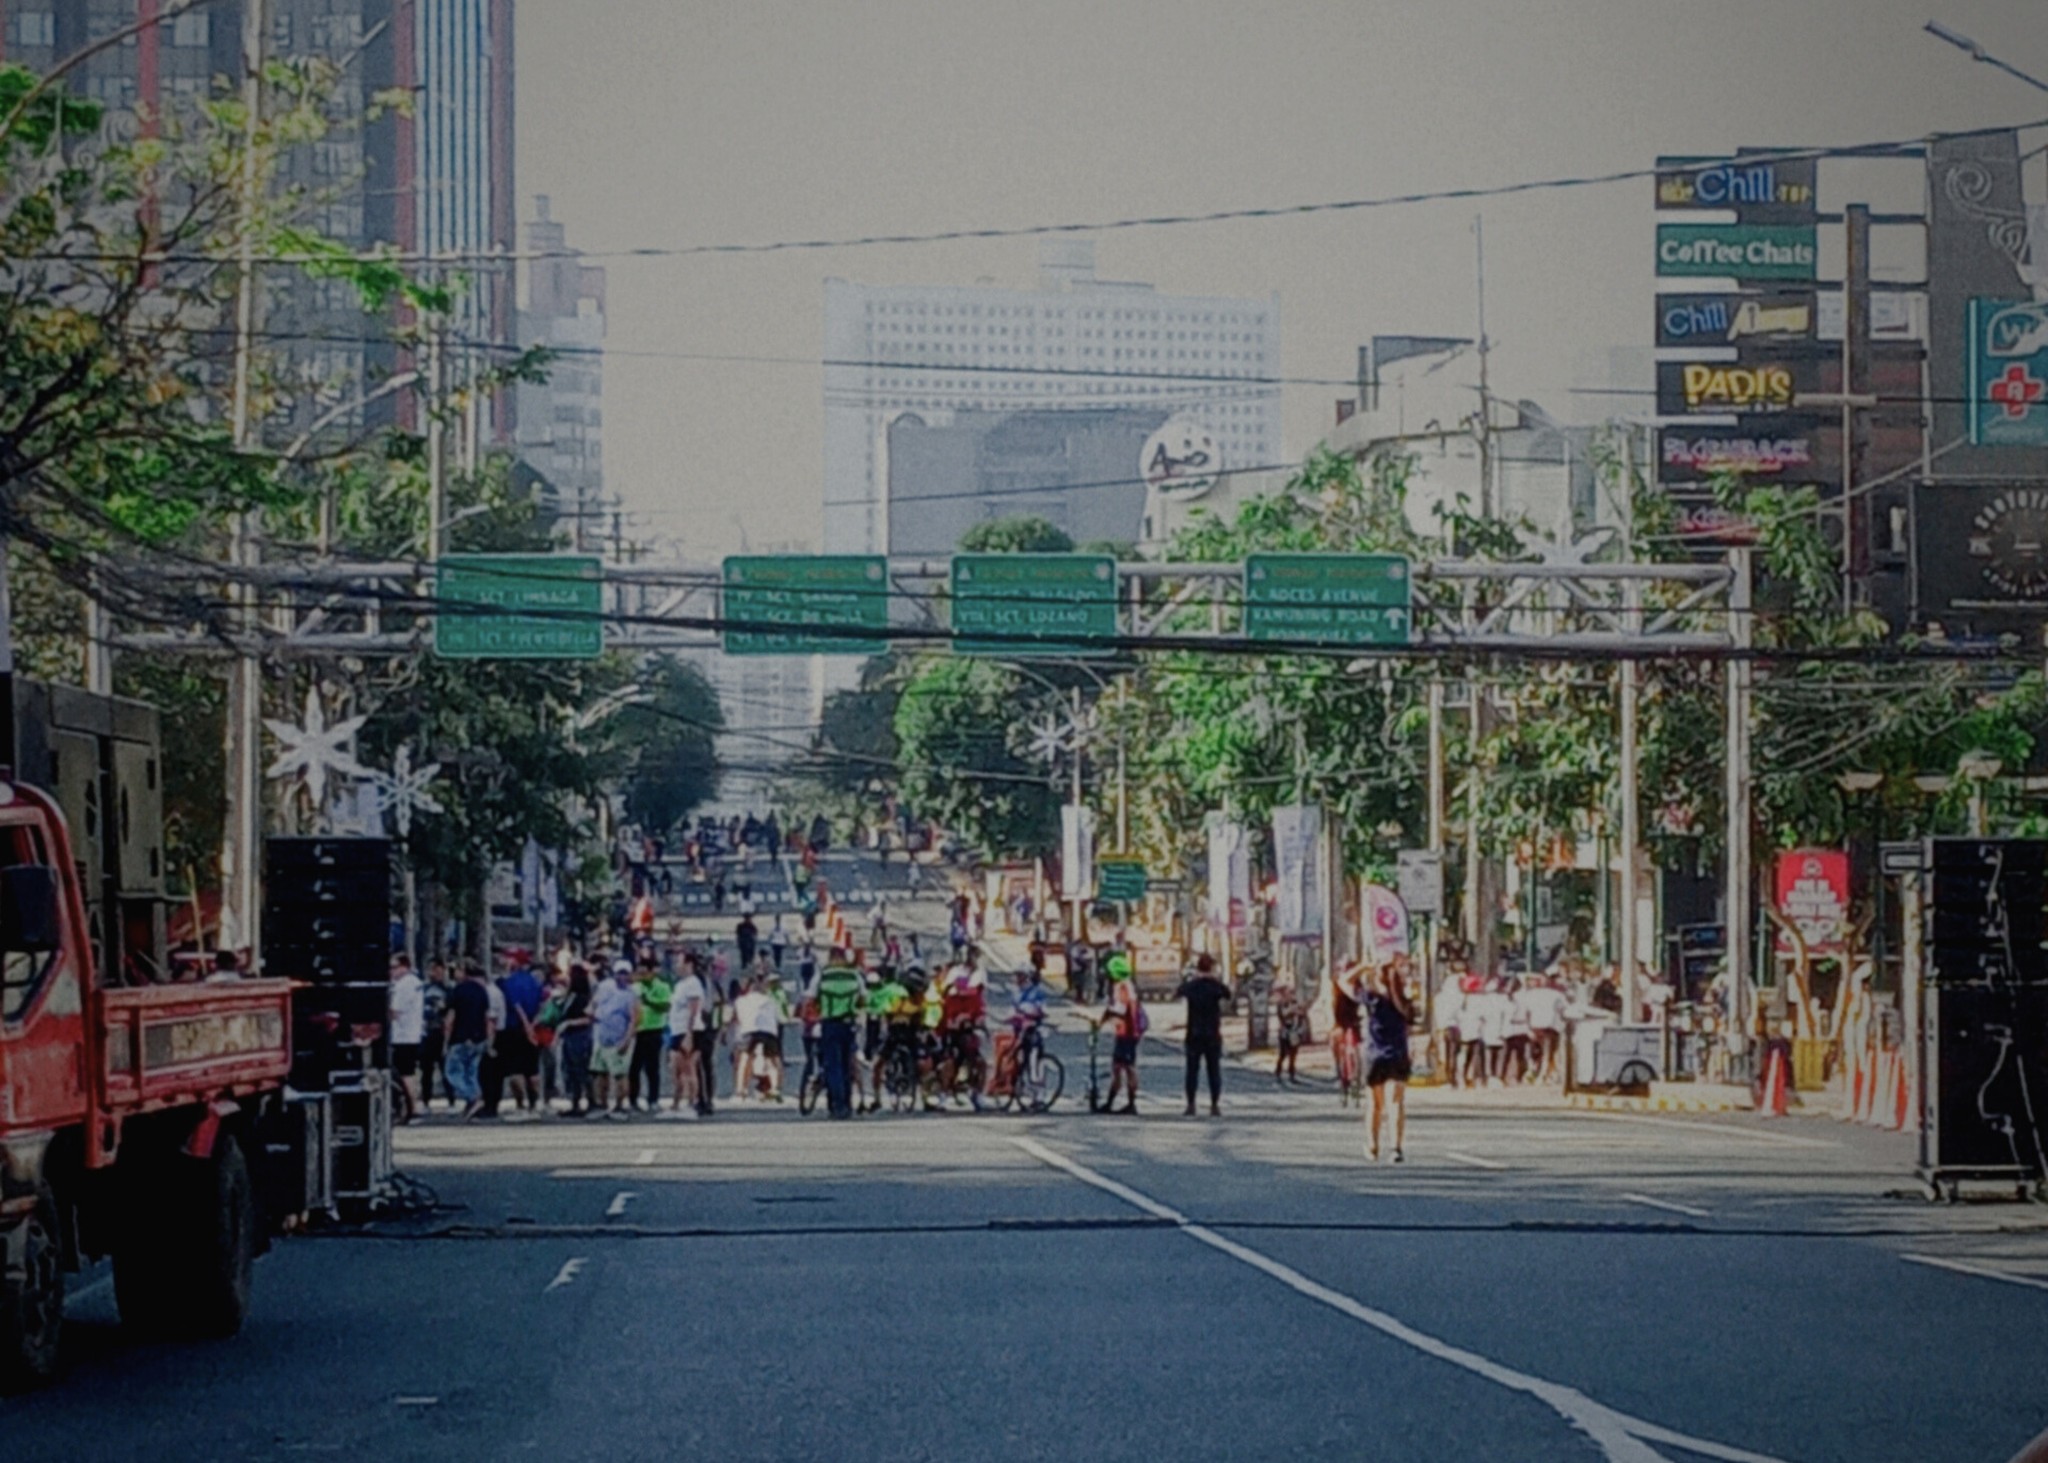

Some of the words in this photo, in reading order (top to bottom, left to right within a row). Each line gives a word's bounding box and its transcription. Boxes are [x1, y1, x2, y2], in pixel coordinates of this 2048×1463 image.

[1696, 163, 1775, 203] Chill
[1660, 240, 1742, 264] Coffee
[1746, 240, 1813, 265] Chats
[1664, 302, 1728, 335] Chill
